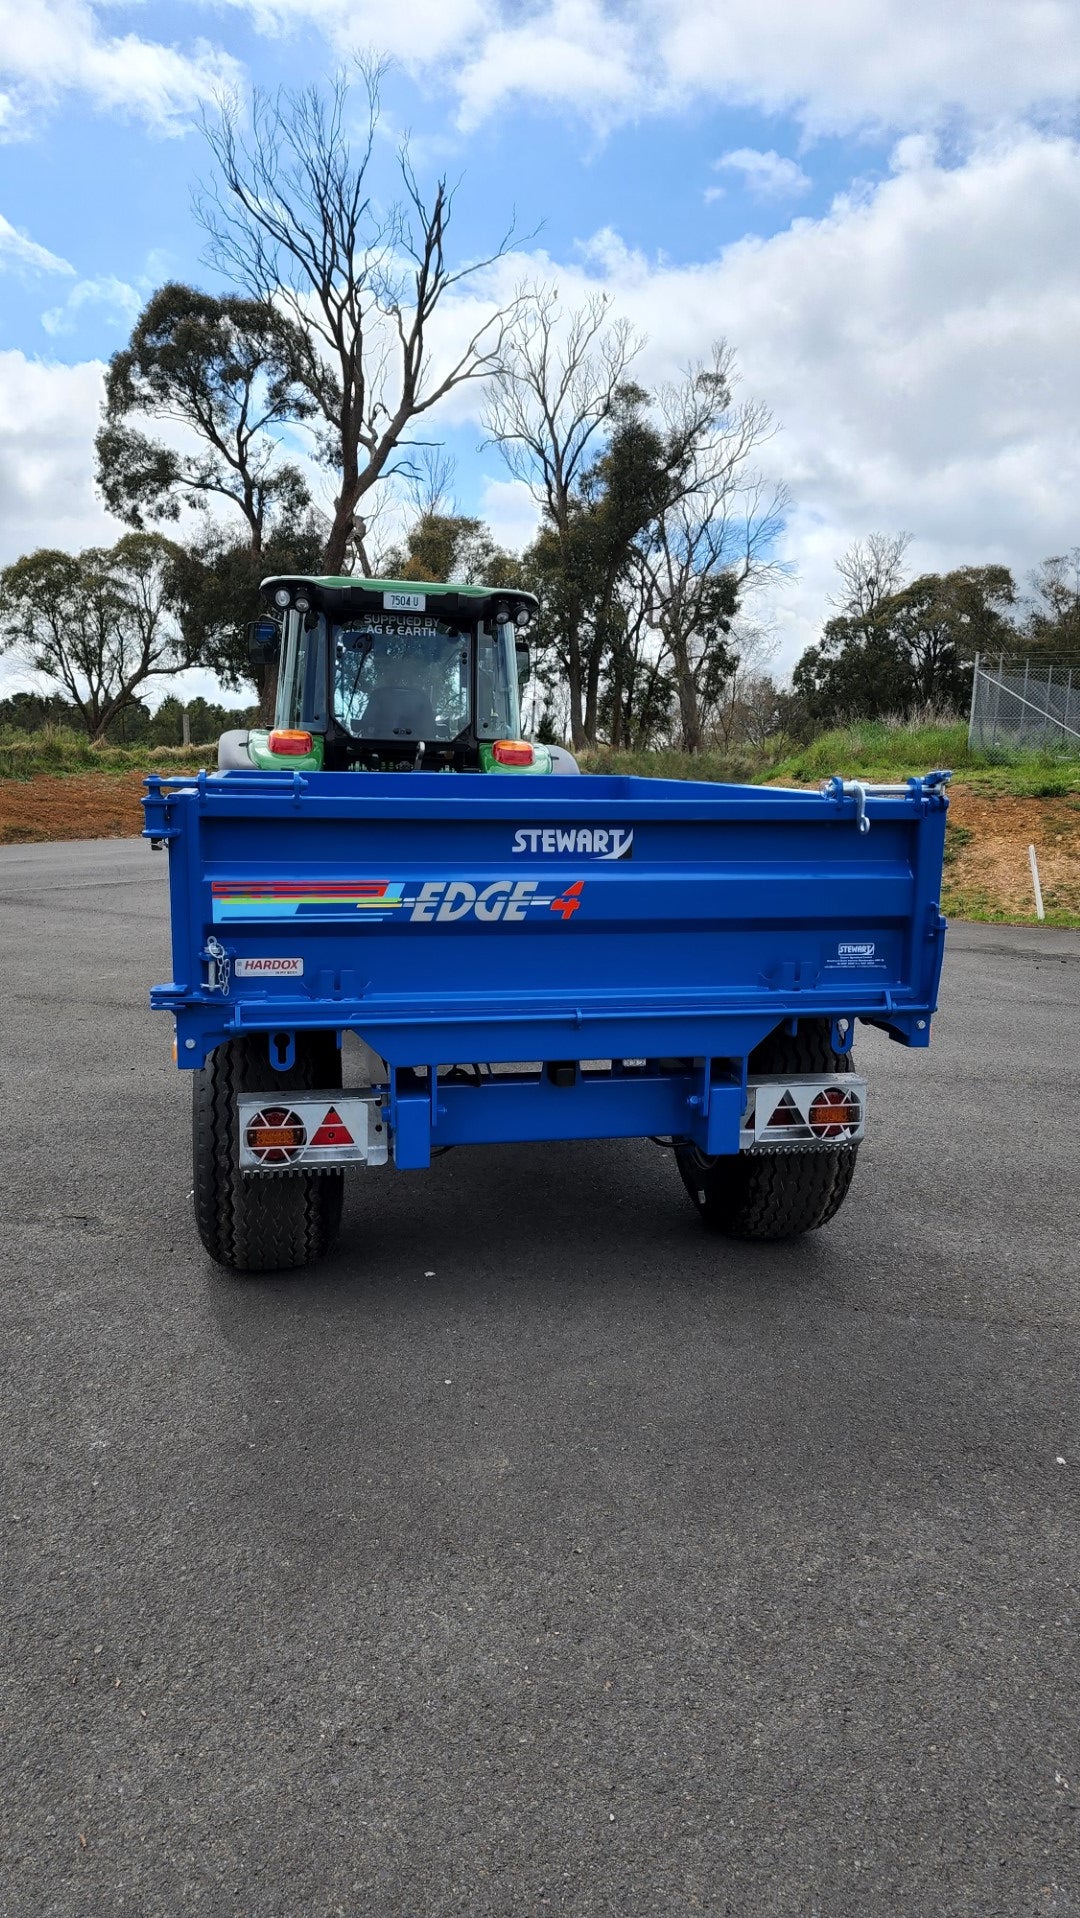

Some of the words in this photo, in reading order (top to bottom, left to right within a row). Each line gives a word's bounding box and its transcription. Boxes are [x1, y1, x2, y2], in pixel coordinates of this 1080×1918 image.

[391, 595, 411, 606] 7504
[413, 597, 419, 607] U
[364, 614, 422, 627] SUPPLIED
[424, 616, 440, 628] BY
[366, 624, 383, 635] AG
[386, 625, 395, 635] &
[397, 625, 436, 637] EARTH
[512, 828, 633, 860] STEWART
[410, 881, 539, 922] EDGE
[550, 880, 585, 920] 4
[840, 945, 873, 955] STEWART
[245, 959, 299, 970] HARDOX
